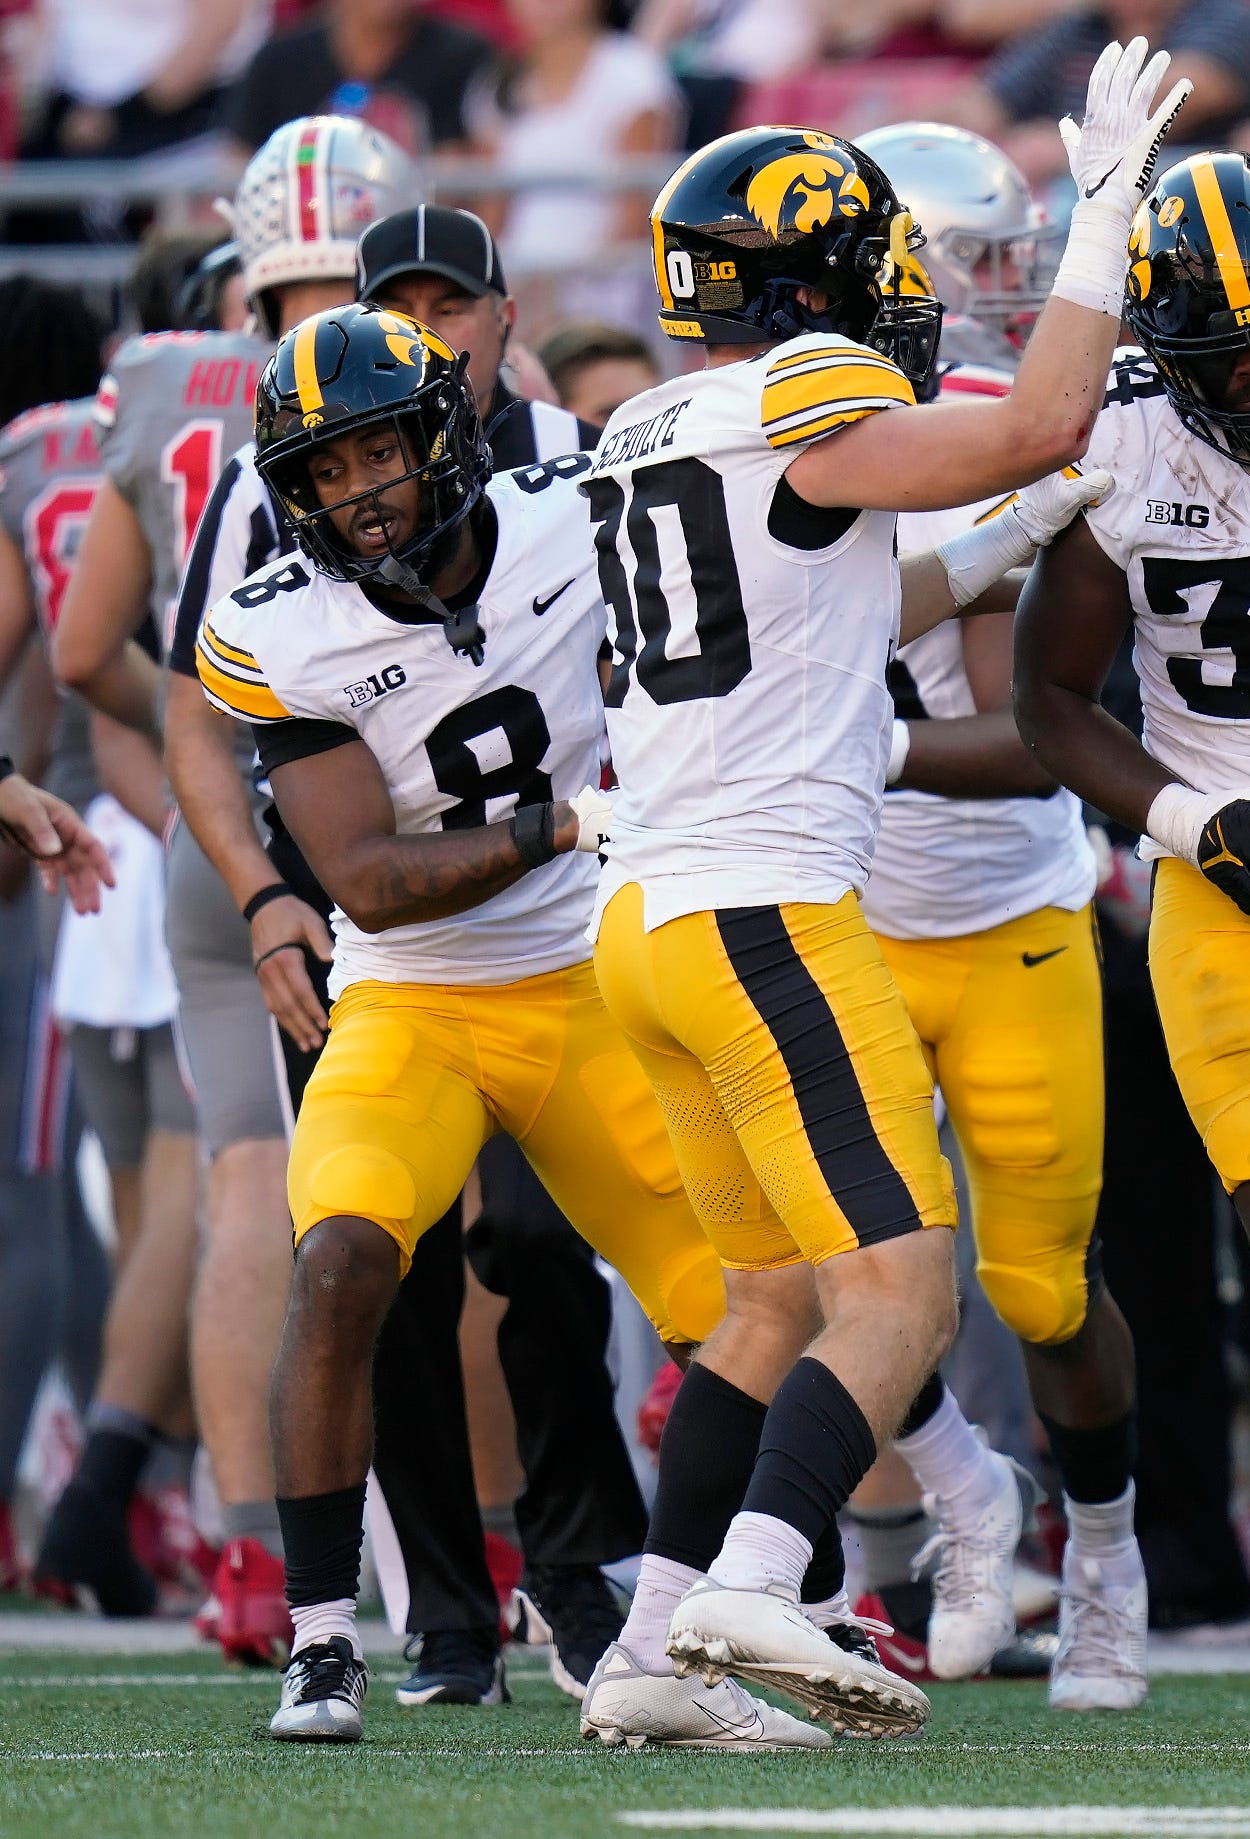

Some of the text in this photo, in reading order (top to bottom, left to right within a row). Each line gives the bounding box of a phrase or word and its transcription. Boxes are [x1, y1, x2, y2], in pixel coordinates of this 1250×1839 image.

[510, 453, 593, 495] 8
[230, 561, 311, 609] 8
[424, 684, 554, 833] 8
